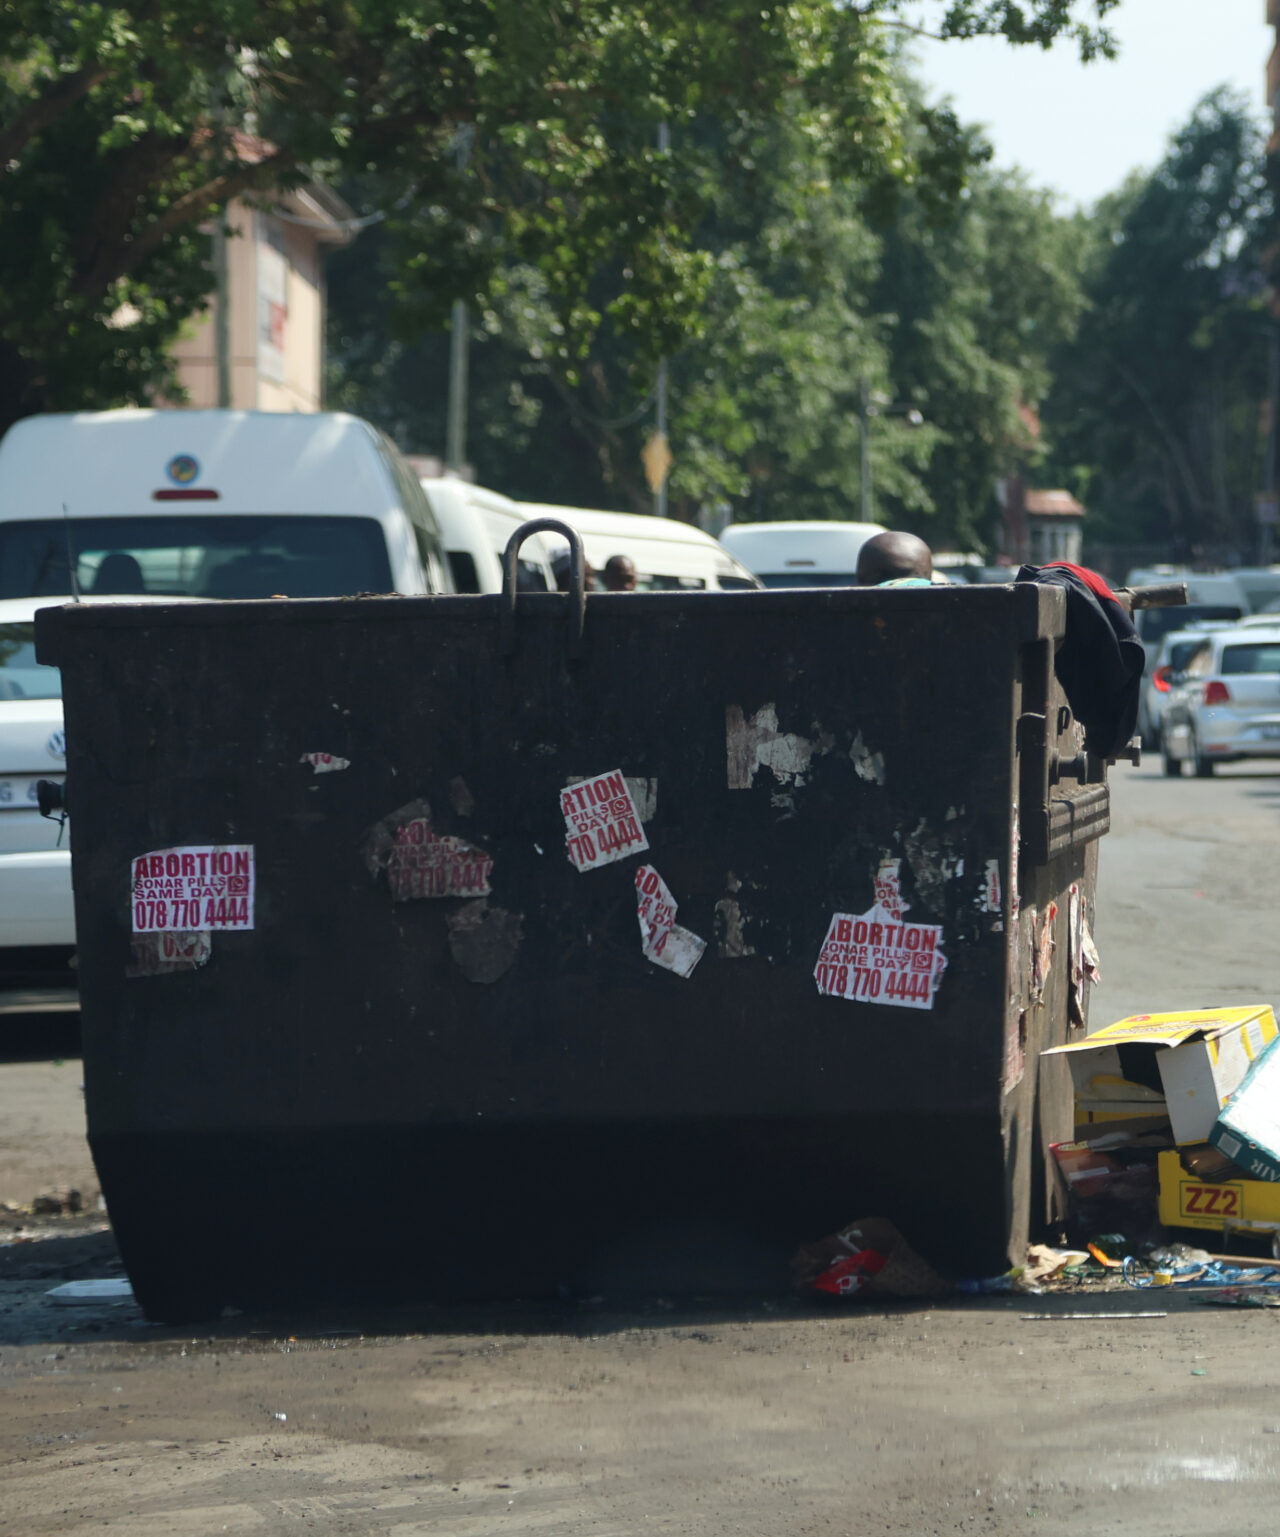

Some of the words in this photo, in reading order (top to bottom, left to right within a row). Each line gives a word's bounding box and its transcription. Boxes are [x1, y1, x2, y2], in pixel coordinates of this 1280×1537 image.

[571, 804, 610, 825] PILLS
[577, 815, 611, 833] DAY
[598, 816, 642, 854] 4444
[135, 852, 249, 878] ABORTION
[135, 879, 184, 889] SONAR
[187, 877, 227, 888] PILLS
[135, 889, 184, 899] SAME
[191, 887, 225, 898] DAY
[135, 900, 167, 930] 078
[171, 899, 200, 928] 770
[205, 898, 249, 926] 4444
[819, 952, 868, 967] SAME
[874, 958, 910, 971] DAY
[872, 948, 912, 961] PILLS
[816, 963, 848, 994] 078
[853, 967, 882, 998] 770
[885, 971, 930, 1003] 4444
[1185, 1187, 1238, 1216] ZZ2
